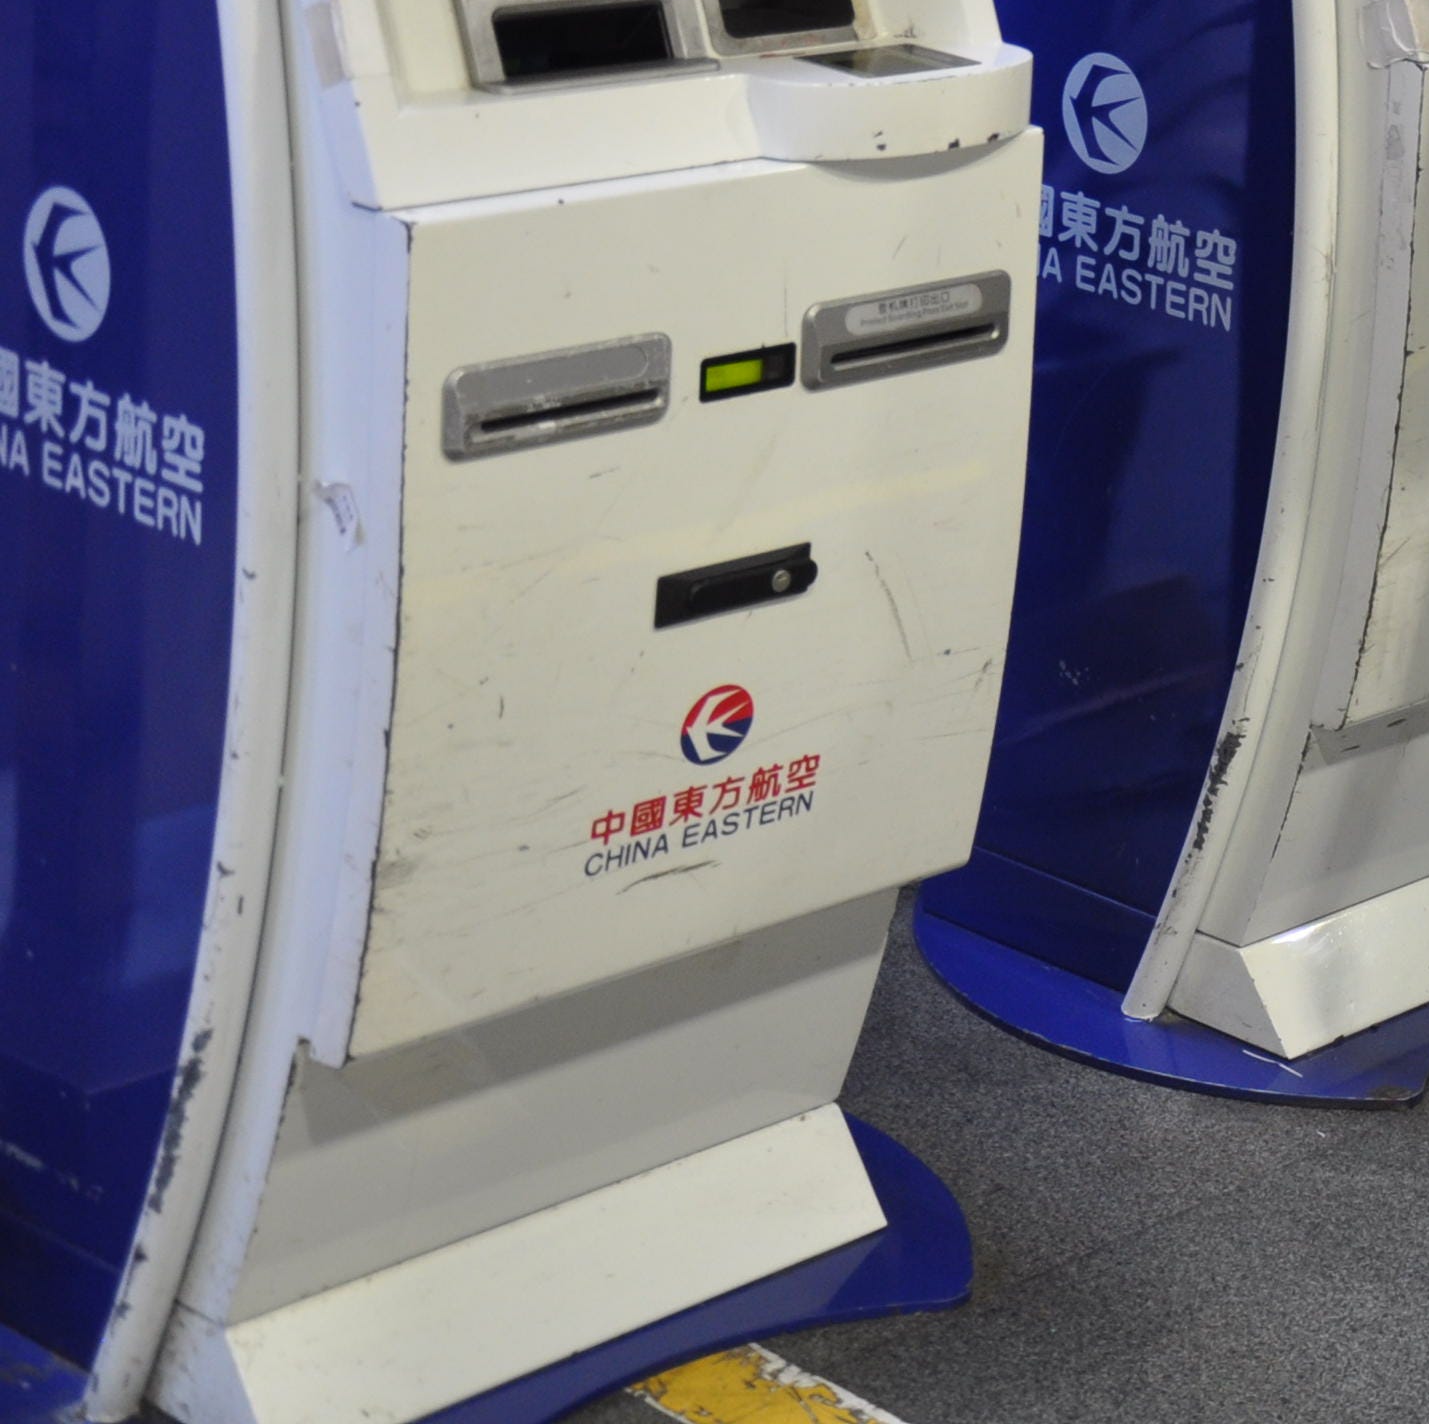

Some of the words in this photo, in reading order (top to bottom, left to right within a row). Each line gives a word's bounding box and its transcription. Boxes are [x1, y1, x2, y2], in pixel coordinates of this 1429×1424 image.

[1038, 243, 1063, 283] A
[1075, 255, 1232, 332] EASTERN
[42, 440, 202, 547] EASTERN
[583, 832, 671, 878] CHINA
[680, 790, 814, 850] EASTERN
[590, 753, 821, 846] 中國東方航空
